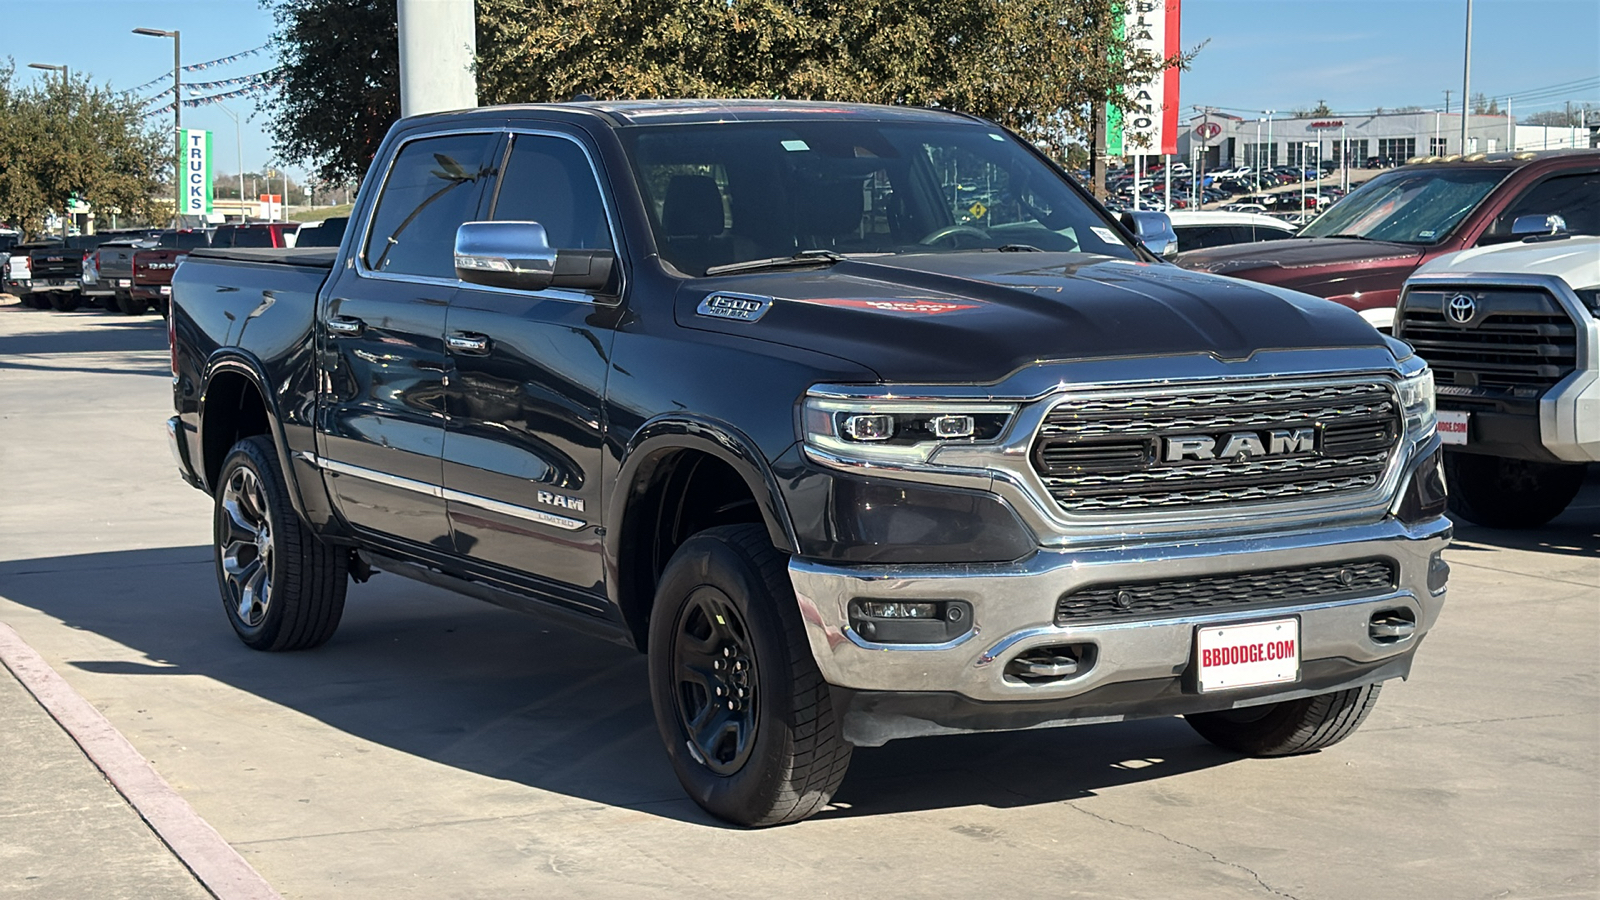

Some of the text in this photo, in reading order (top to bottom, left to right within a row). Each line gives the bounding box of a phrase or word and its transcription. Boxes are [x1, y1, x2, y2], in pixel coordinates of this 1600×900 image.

[190, 135, 203, 209] TRUCKS
[148, 262, 176, 270] RAM
[712, 296, 761, 311] 1500
[1166, 428, 1315, 461] RAM
[537, 490, 585, 512] RAM
[538, 514, 574, 528] LIMITED
[1202, 640, 1295, 667] BBDODGE.COM
